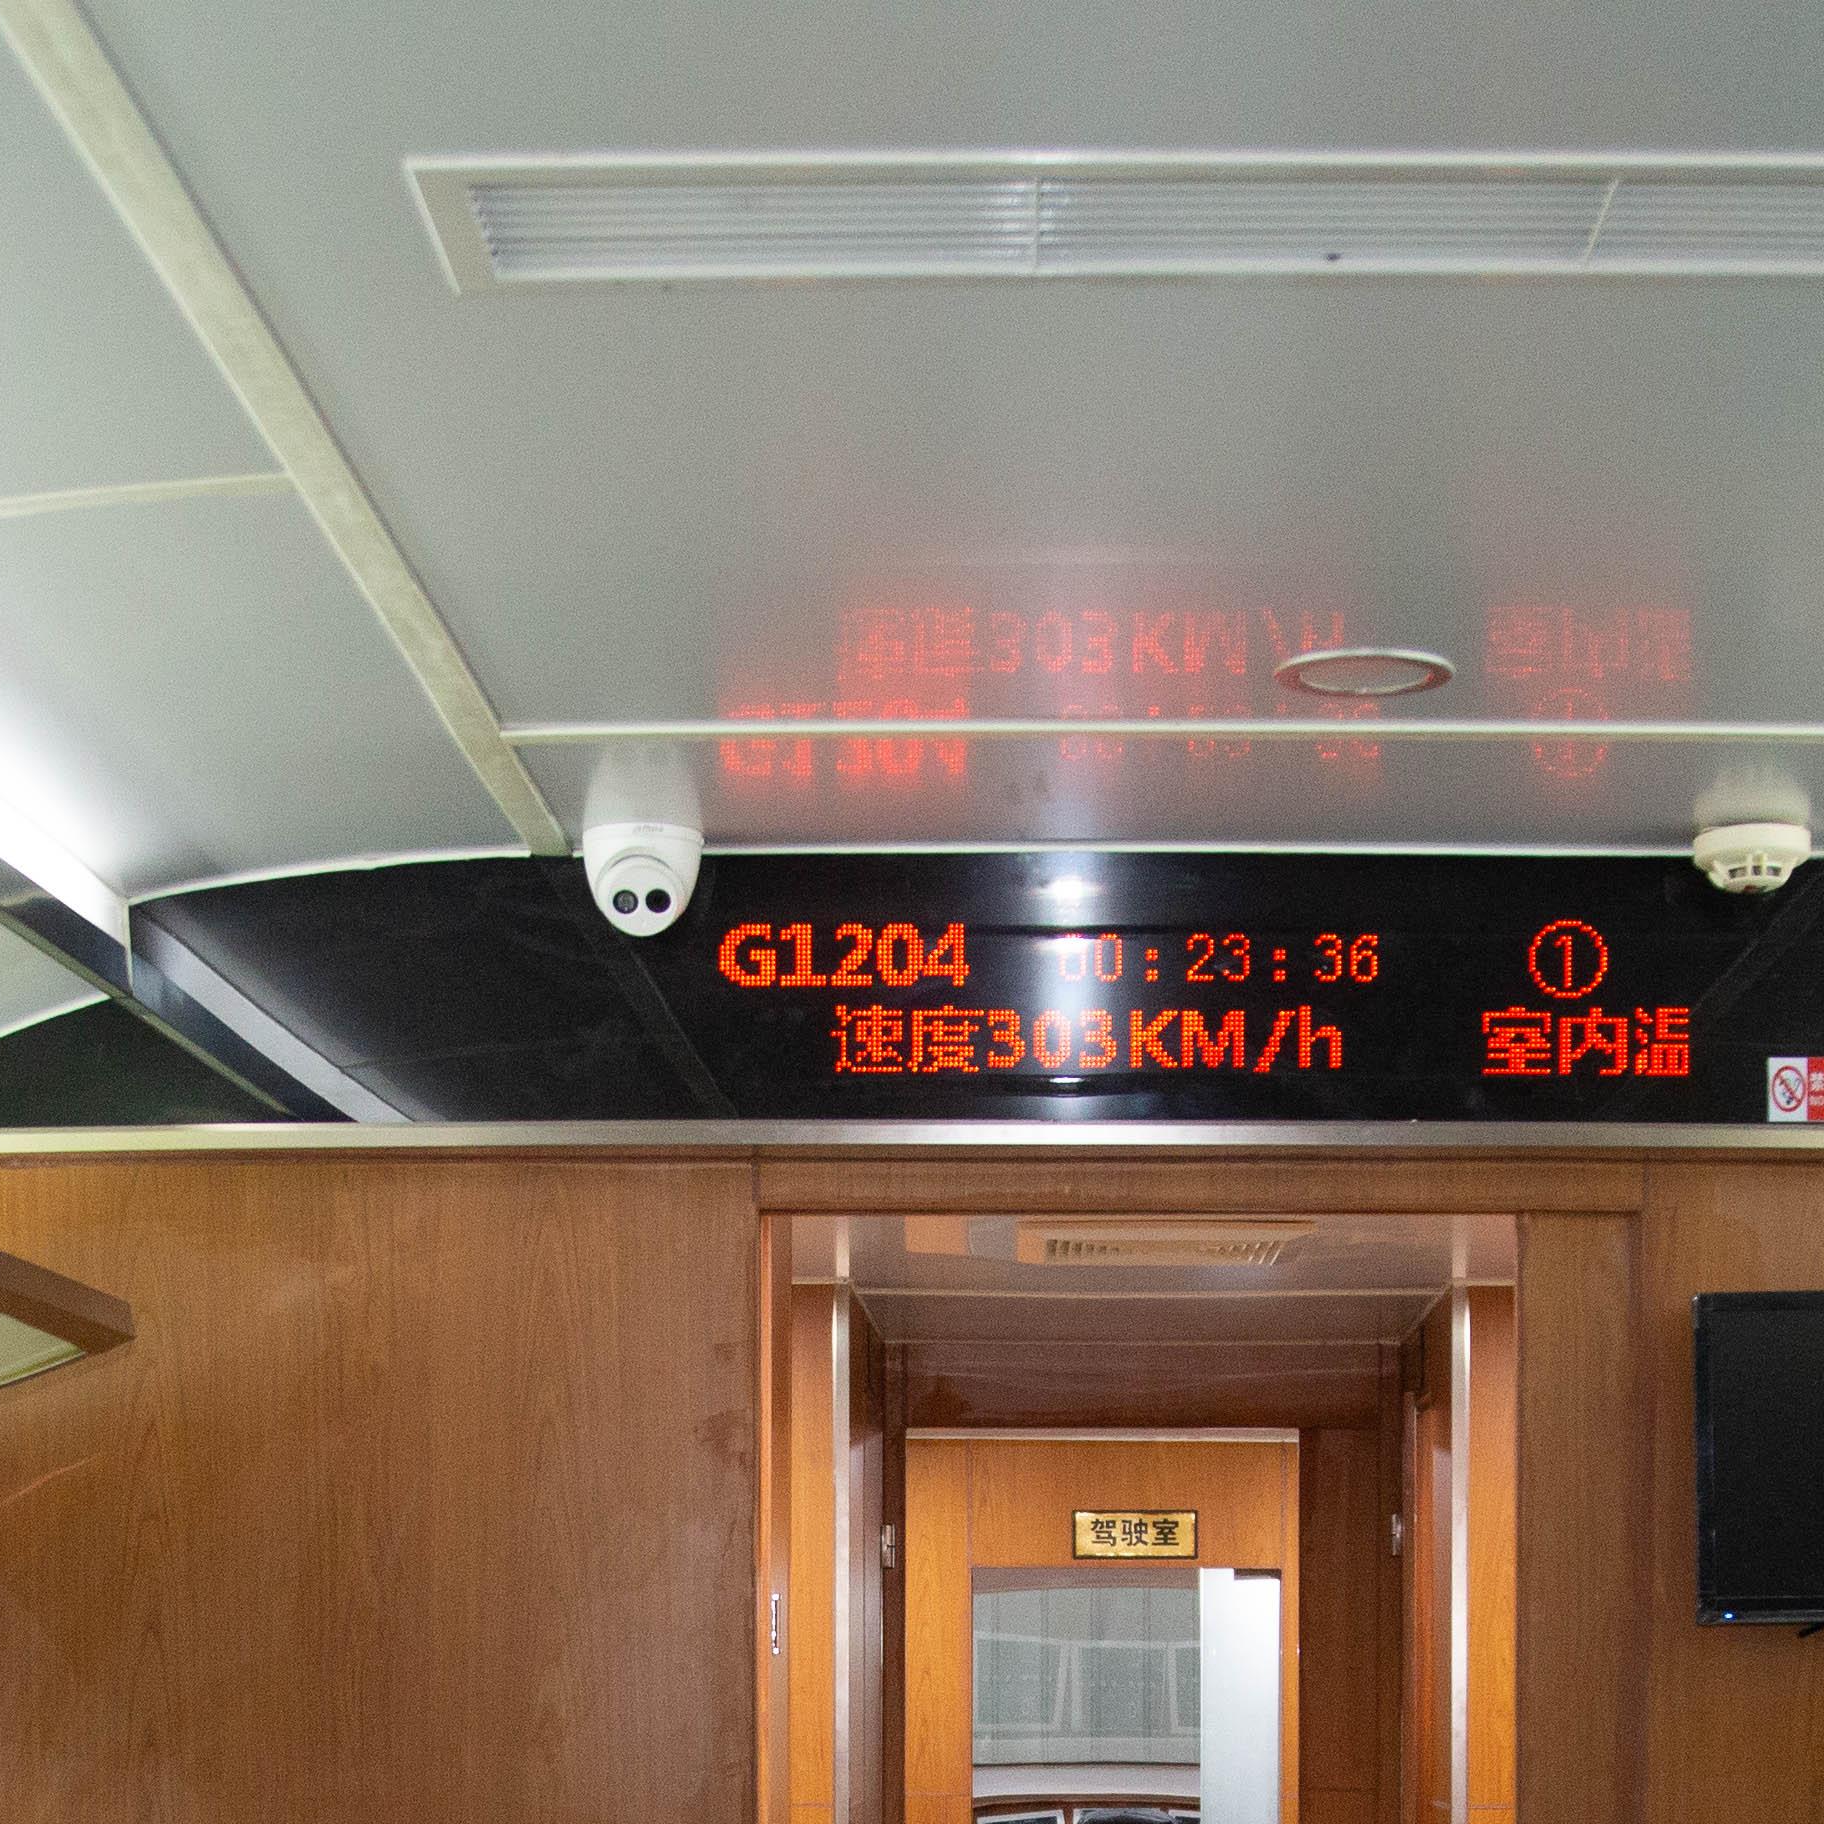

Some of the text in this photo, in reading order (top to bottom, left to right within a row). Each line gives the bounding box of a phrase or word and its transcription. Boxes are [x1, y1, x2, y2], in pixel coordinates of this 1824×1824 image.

[718, 922, 970, 988] G1204
[1091, 1518, 1180, 1546] 驾驶室
